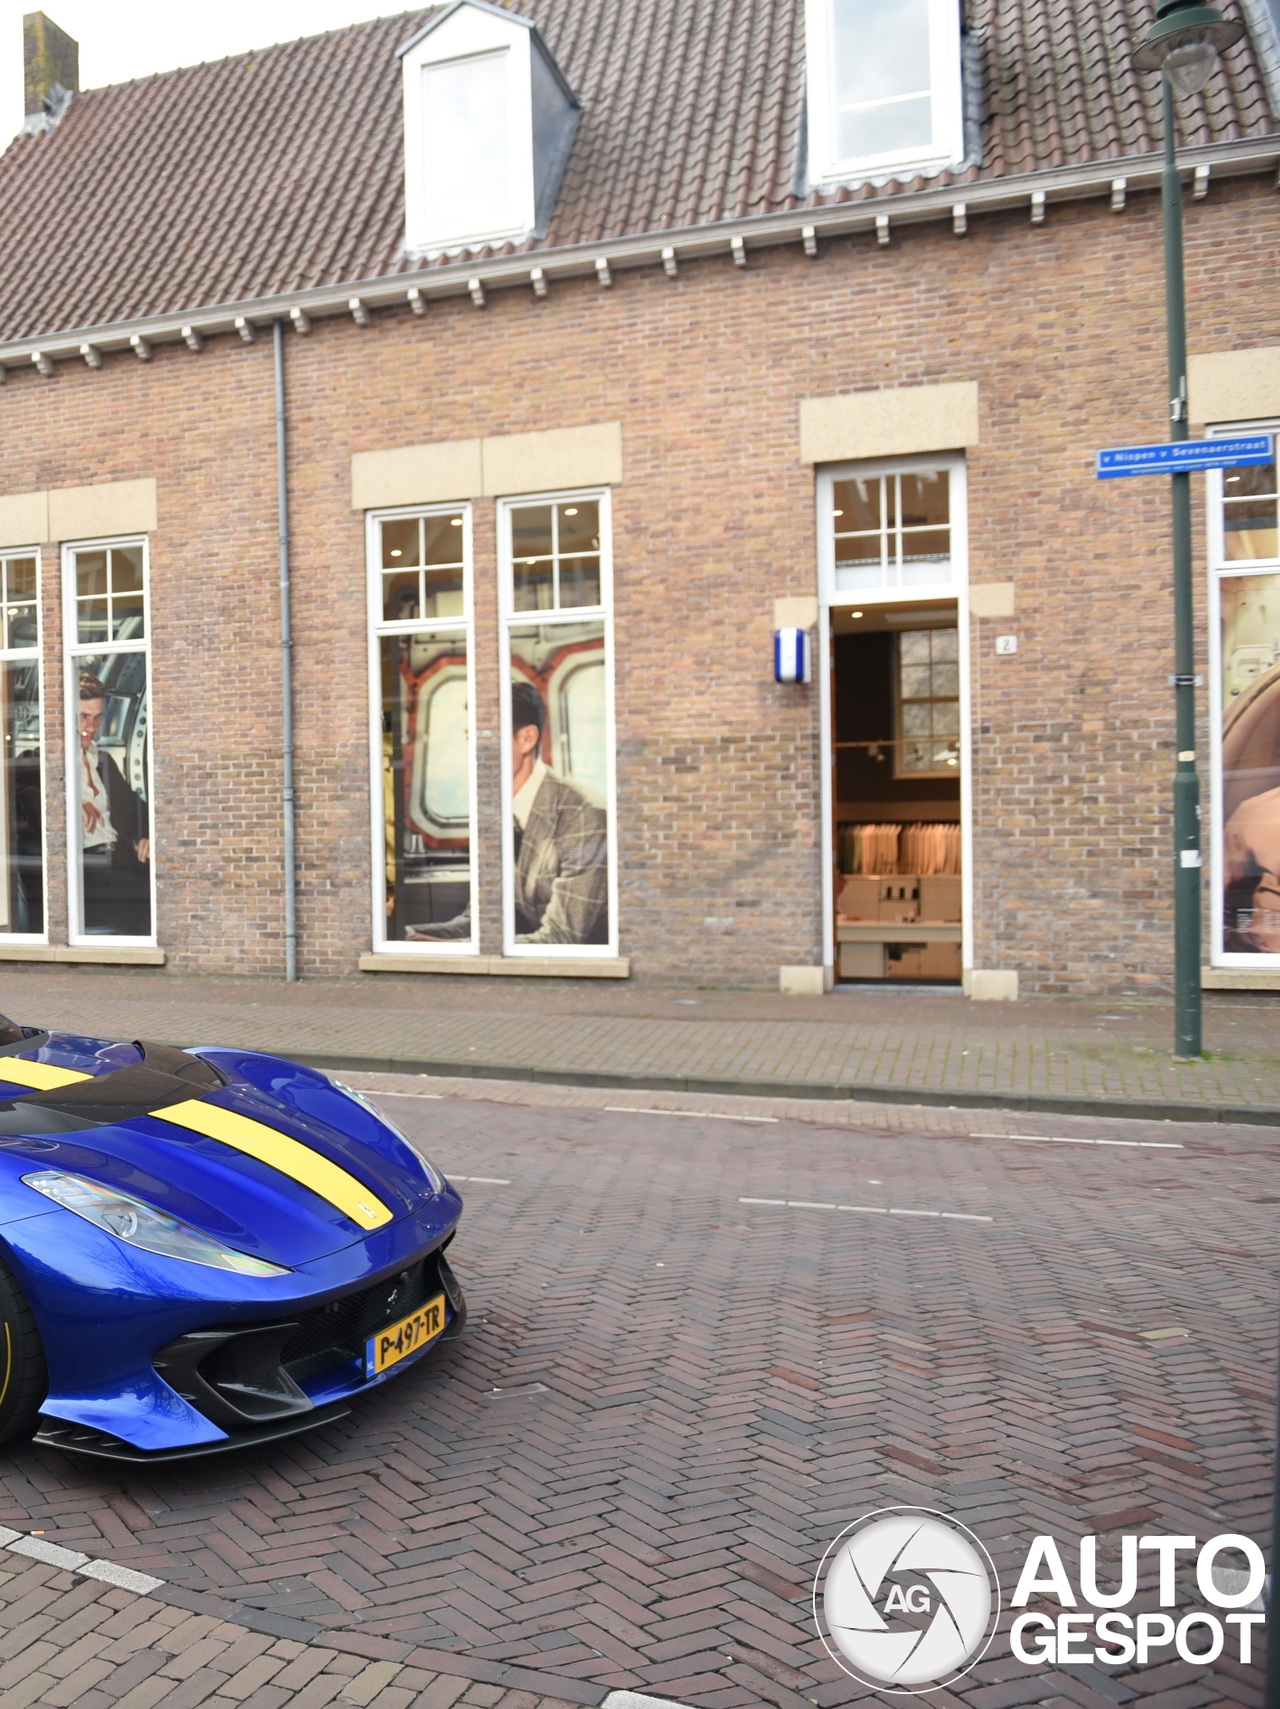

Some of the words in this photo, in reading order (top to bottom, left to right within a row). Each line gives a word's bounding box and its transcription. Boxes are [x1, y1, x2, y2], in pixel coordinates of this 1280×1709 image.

[1114, 451, 1156, 462] Nispen
[1003, 638, 1011, 651] 2
[381, 1304, 440, 1365] P-497-TR
